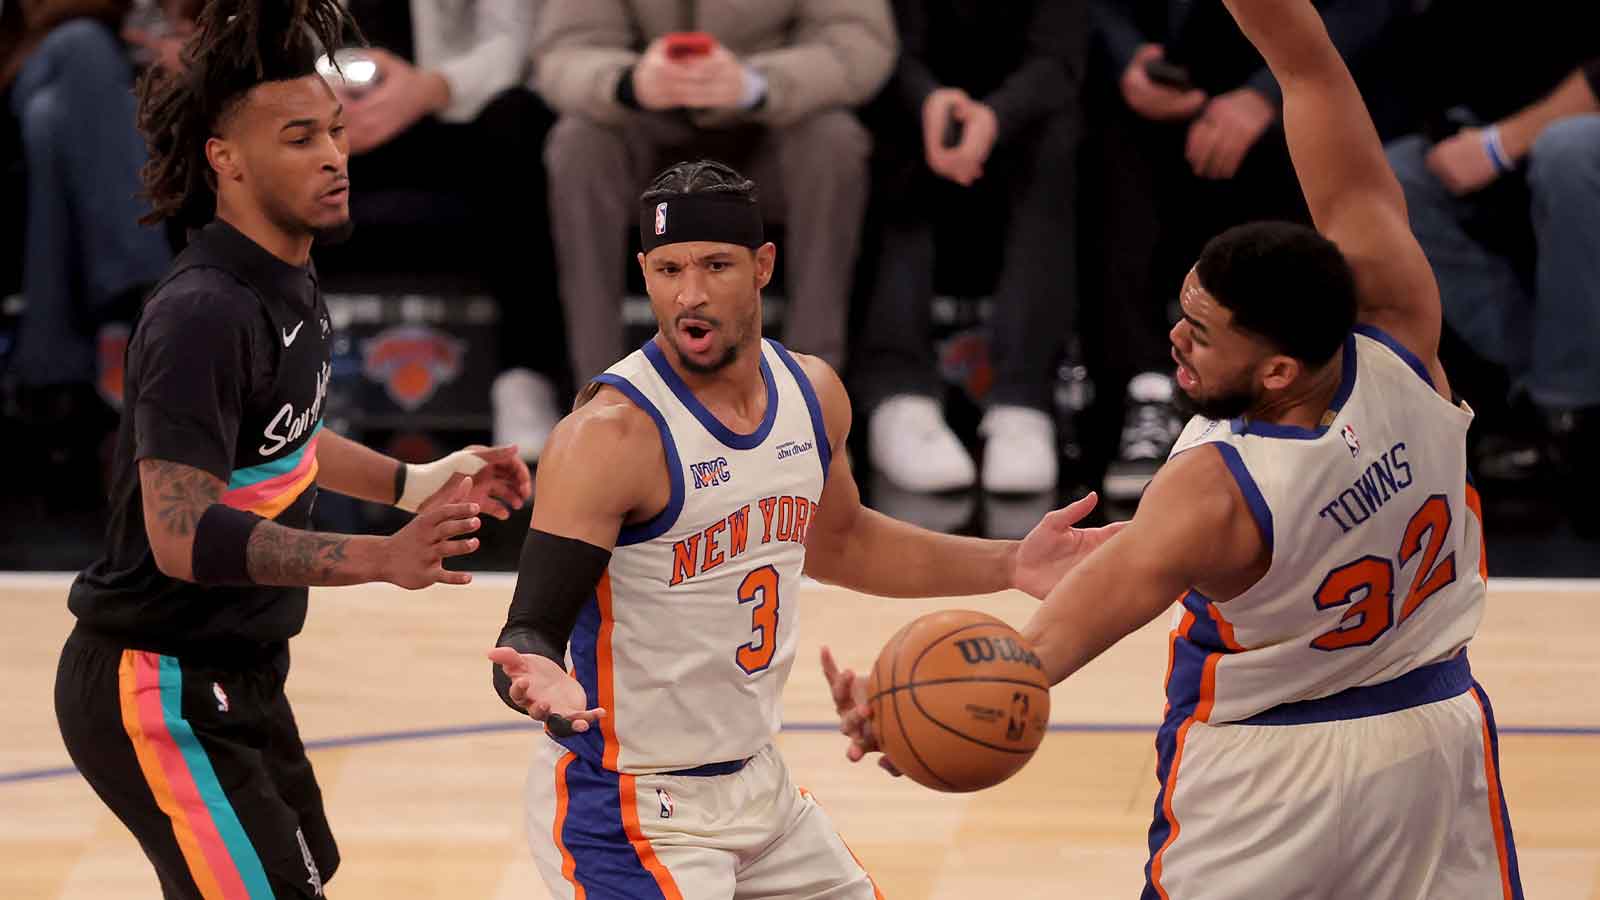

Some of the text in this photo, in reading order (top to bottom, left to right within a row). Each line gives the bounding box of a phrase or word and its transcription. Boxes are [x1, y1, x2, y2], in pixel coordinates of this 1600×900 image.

[258, 402, 311, 457] San
[690, 457, 731, 489] NYC
[1319, 442, 1414, 534] TOWNS
[669, 504, 750, 587] NEW
[1309, 494, 1457, 652] 32
[736, 563, 780, 676] 3
